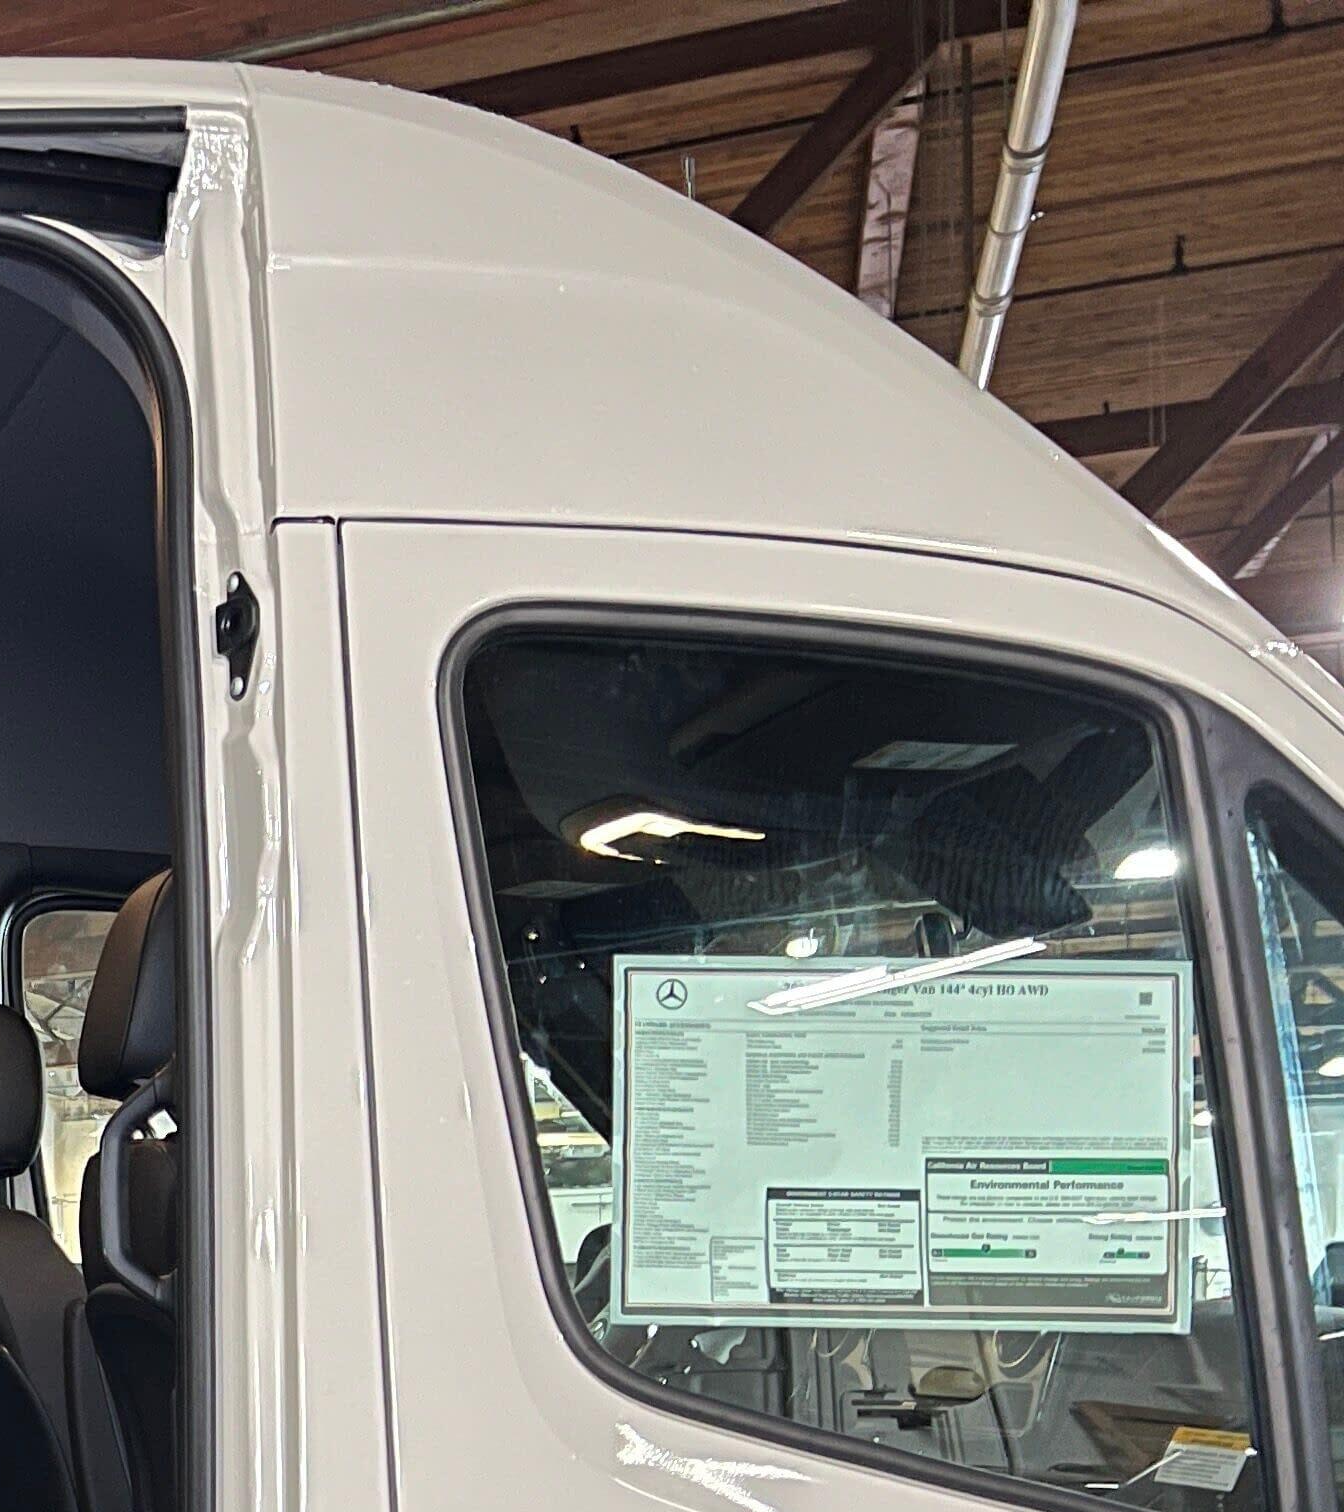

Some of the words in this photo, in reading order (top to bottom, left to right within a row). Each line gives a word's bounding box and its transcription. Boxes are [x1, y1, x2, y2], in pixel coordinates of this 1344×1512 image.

[913, 984, 936, 995] Van
[968, 984, 993, 998] 4cyl
[1018, 984, 1049, 996] AWD
[970, 1179, 1050, 1190] Environmental
[1053, 1180, 1124, 1190] Performance
